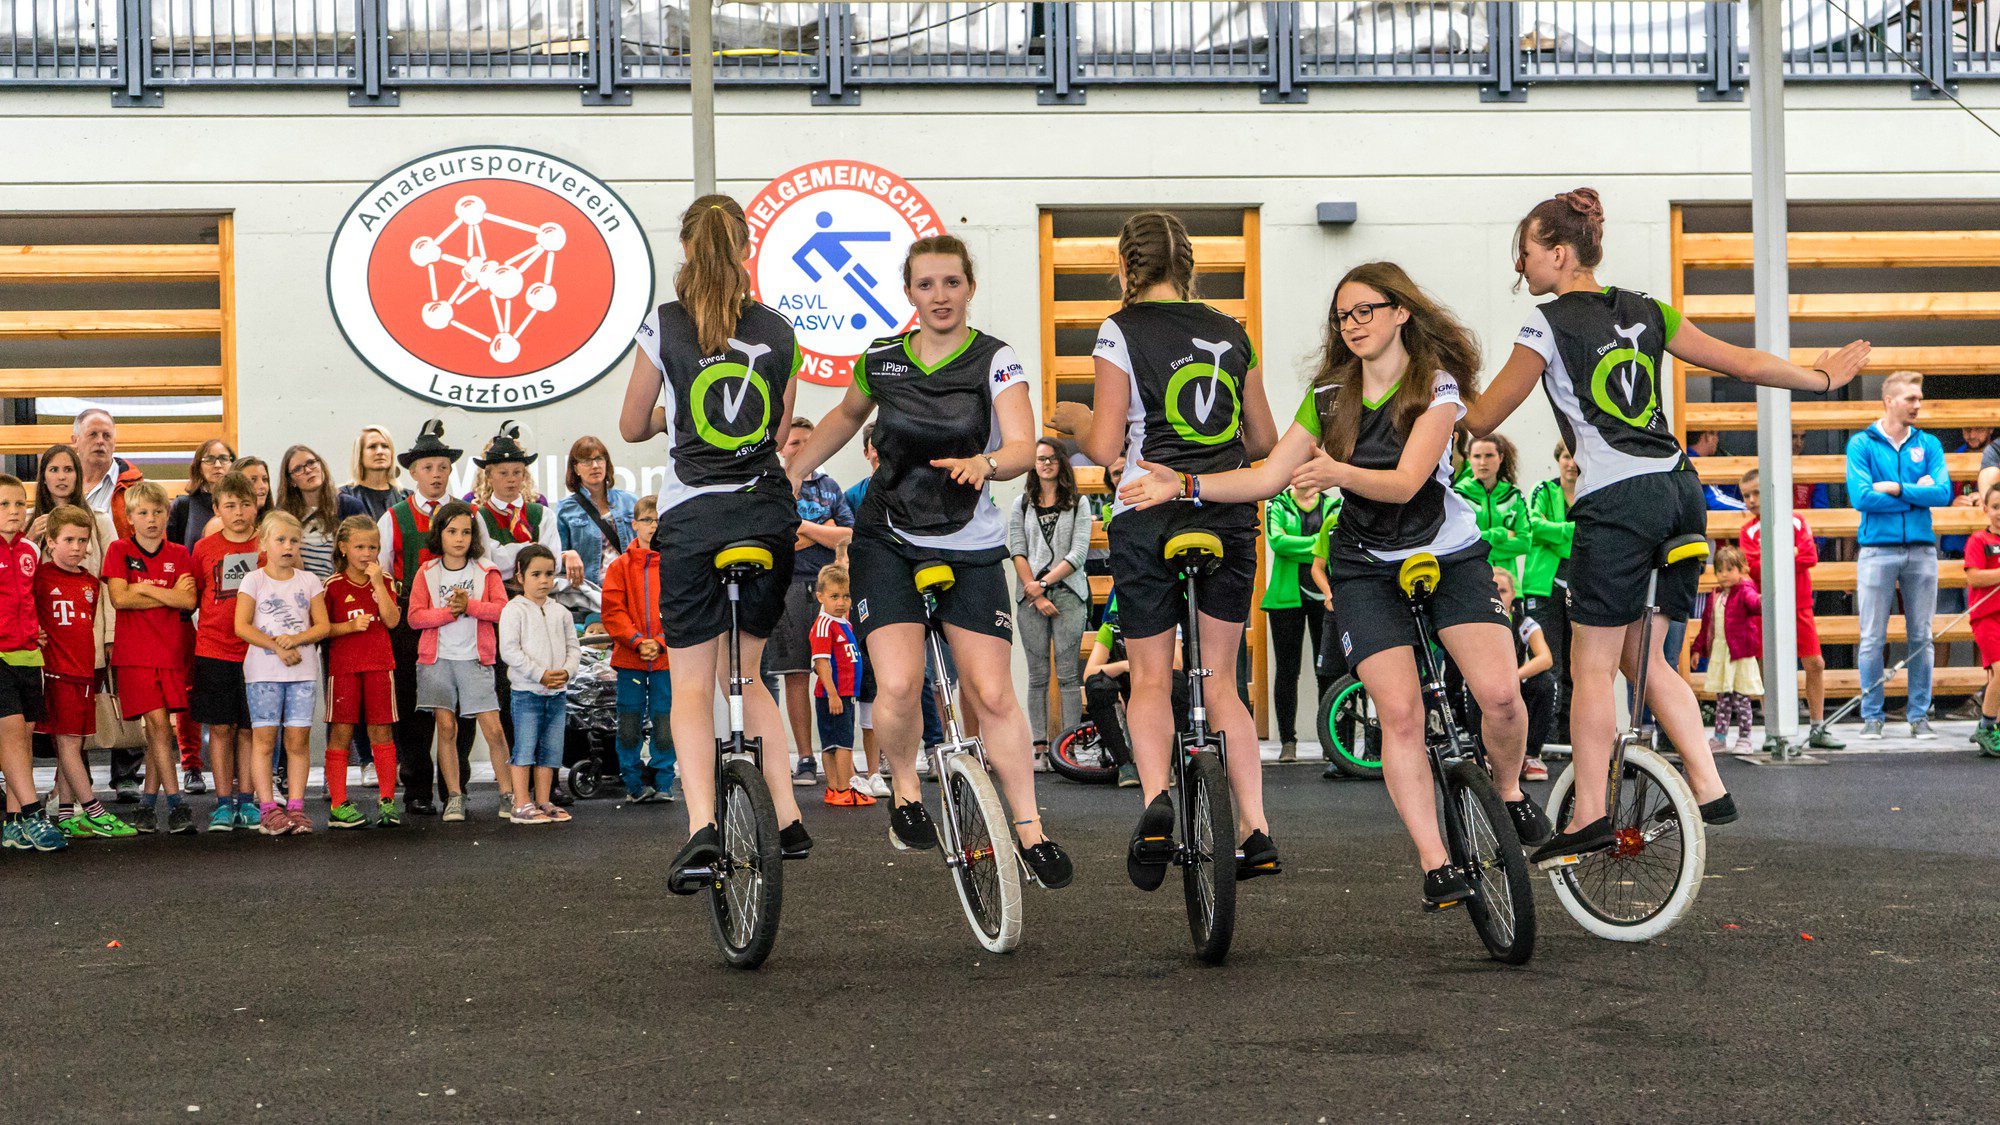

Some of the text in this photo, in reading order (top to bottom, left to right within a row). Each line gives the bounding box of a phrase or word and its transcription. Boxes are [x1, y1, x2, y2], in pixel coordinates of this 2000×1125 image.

[358, 152, 622, 233] Amateursportverein
[747, 165, 940, 259] PIELGEMEINSCHA
[778, 294, 829, 310] ASVL
[793, 315, 846, 330] ASVV
[698, 352, 727, 368] Einrad
[882, 361, 909, 373] iPlan
[1170, 353, 1194, 370] Einrad
[429, 373, 556, 405] Latzfons
[224, 570, 246, 580] adid
